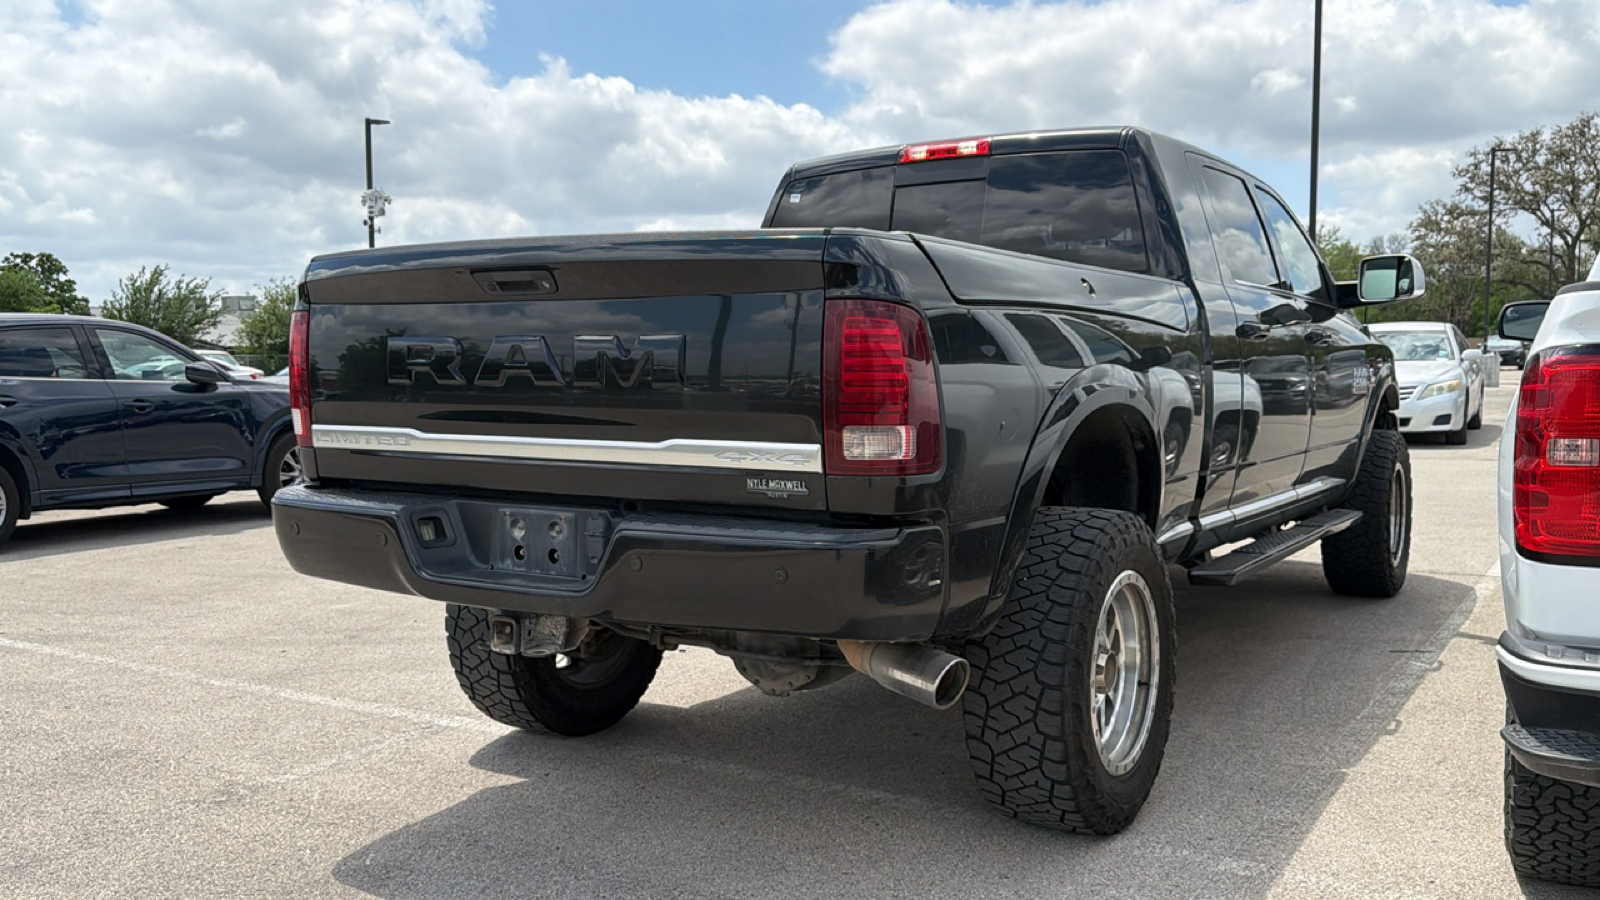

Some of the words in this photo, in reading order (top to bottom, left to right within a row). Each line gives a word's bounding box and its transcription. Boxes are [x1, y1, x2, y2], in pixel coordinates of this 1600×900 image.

[387, 335, 686, 388] RAM
[316, 432, 411, 446] LIMITED
[747, 478, 767, 489] NYLE
[768, 479, 806, 491] MAXWELL
